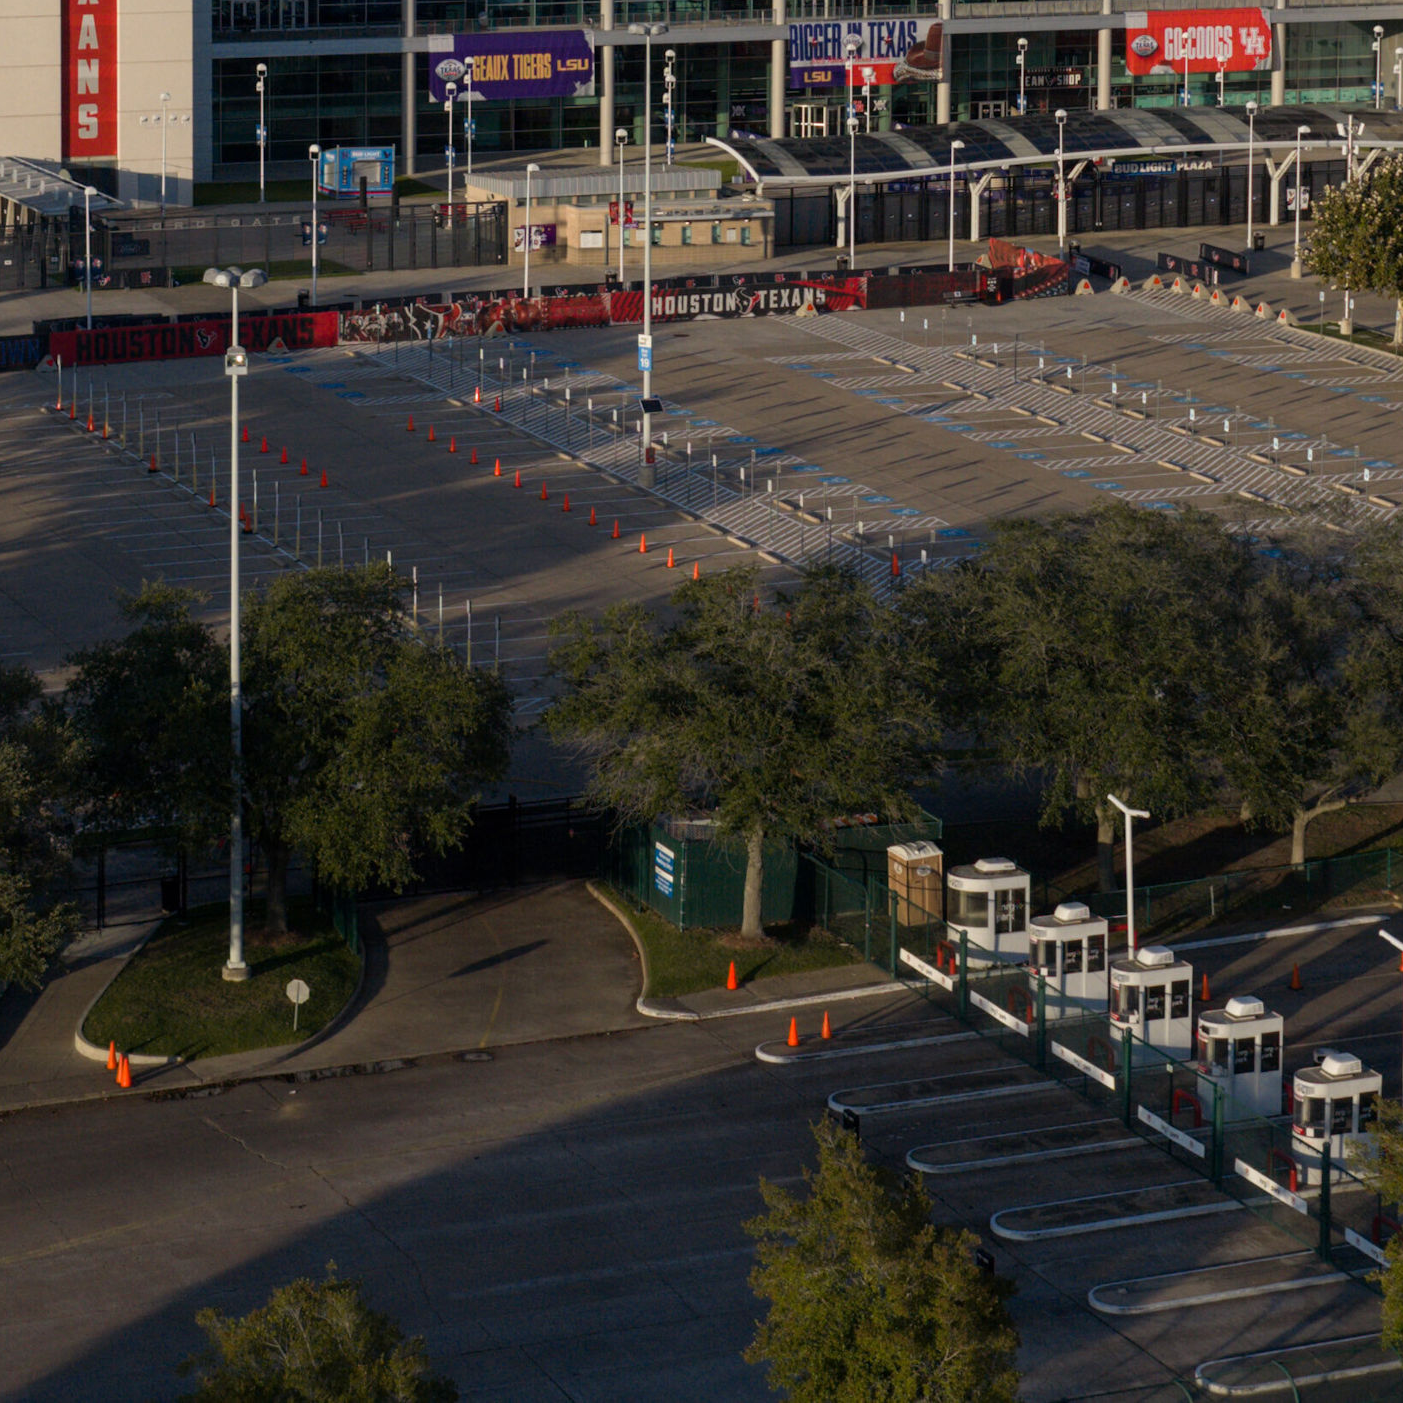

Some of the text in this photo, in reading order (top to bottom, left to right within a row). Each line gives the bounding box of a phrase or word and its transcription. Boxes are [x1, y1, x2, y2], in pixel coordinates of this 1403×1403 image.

[788, 22, 842, 62] BIGGER
[867, 20, 917, 59] TEXAS
[1164, 25, 1233, 61] GO COOGS
[472, 53, 552, 82] GEAUX TIGERS
[556, 58, 589, 72] LSU
[803, 70, 832, 83] LSU
[1019, 73, 1082, 87] EAM SHOP
[1113, 160, 1214, 174] BUD LIGHT PLAZA
[650, 287, 827, 318] HOUSTON TEXANS
[76, 325, 195, 362] HOUSTON
[640, 357, 650, 368] 19
